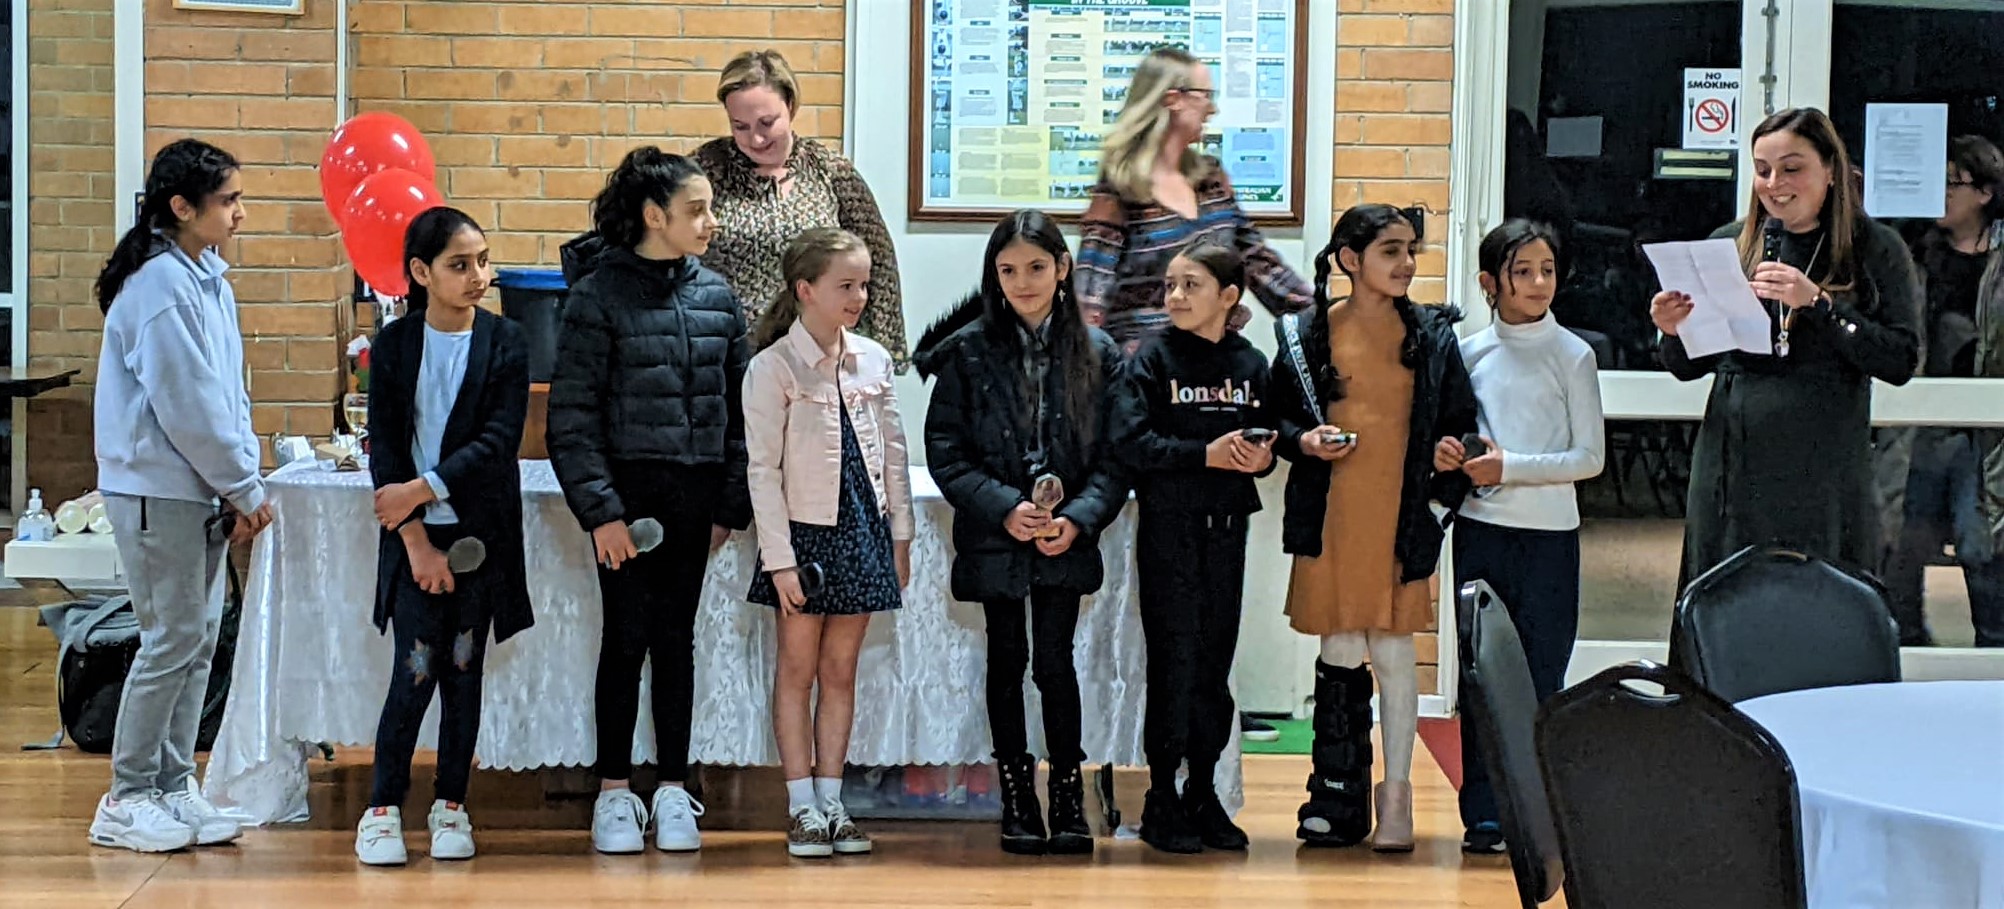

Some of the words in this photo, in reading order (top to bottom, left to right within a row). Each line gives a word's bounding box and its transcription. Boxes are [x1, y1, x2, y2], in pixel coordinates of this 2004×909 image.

[1705, 72, 1722, 80] NO
[1687, 81, 1739, 90] SMOKING
[1170, 378, 1260, 409] lonsdal.
